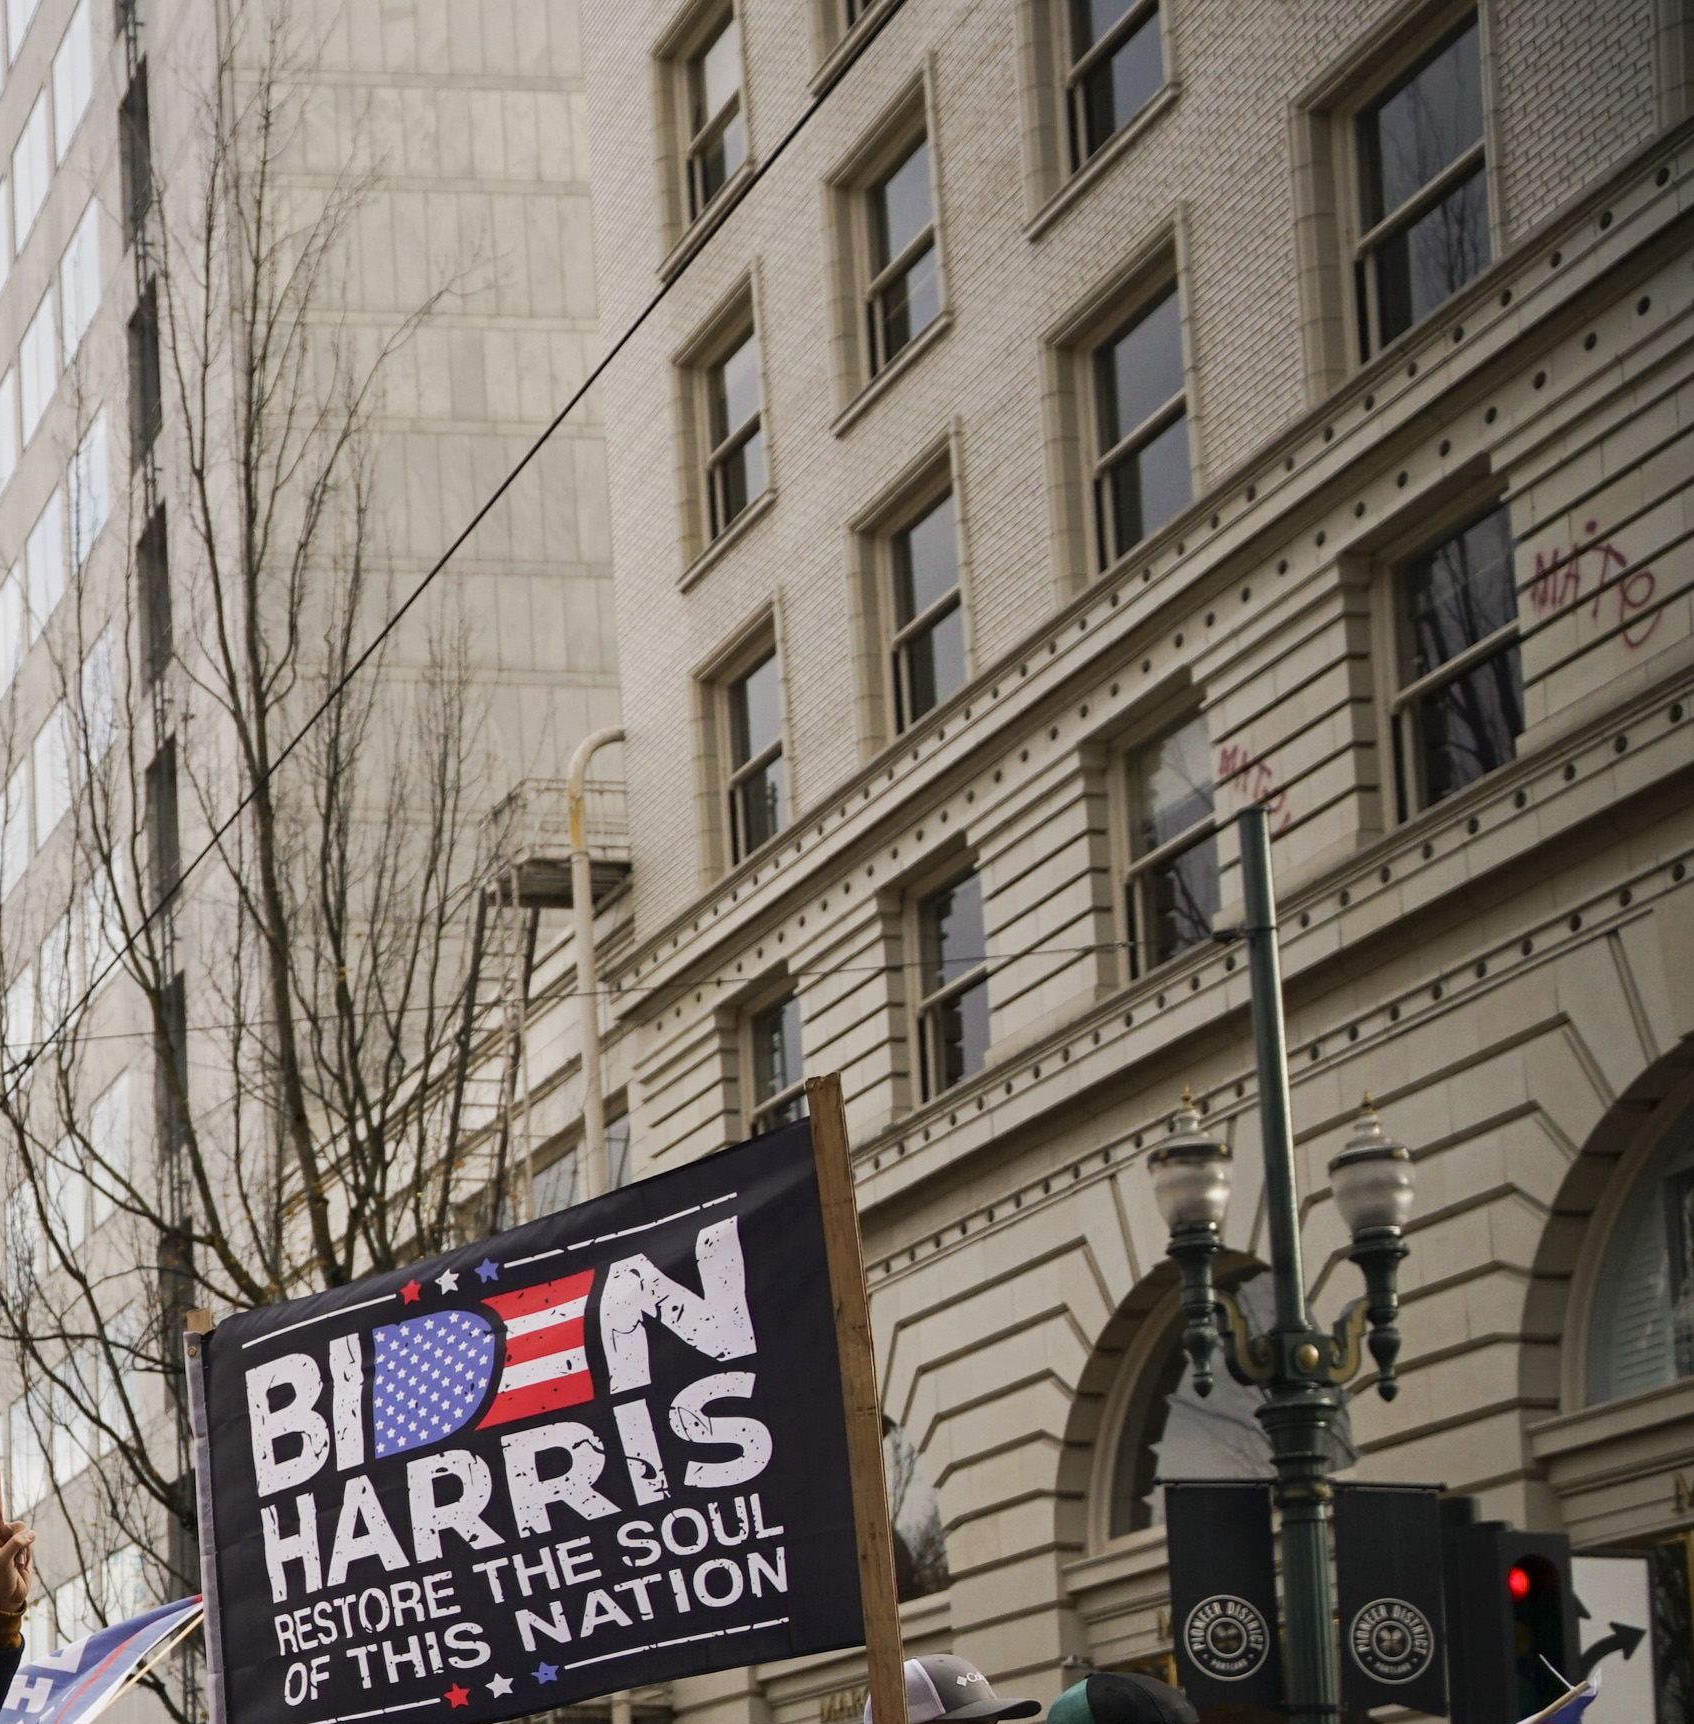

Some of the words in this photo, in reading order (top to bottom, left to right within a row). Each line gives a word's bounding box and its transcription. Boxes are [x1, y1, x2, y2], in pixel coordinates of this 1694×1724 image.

[244, 1215, 759, 1497] BIDEN
[260, 1371, 773, 1602] HARRIS
[275, 1570, 462, 1657] RESTORE
[472, 1535, 603, 1604] THE
[615, 1493, 785, 1568] SOUL
[284, 1655, 332, 1707] OF
[346, 1622, 492, 1690] THIS
[514, 1546, 789, 1652] NATION
[1189, 1601, 1223, 1652] PIONEER
[1225, 1601, 1264, 1651] DISTRICT
[1355, 1604, 1389, 1654] PIONEER
[1392, 1604, 1429, 1656] DISTRICT
